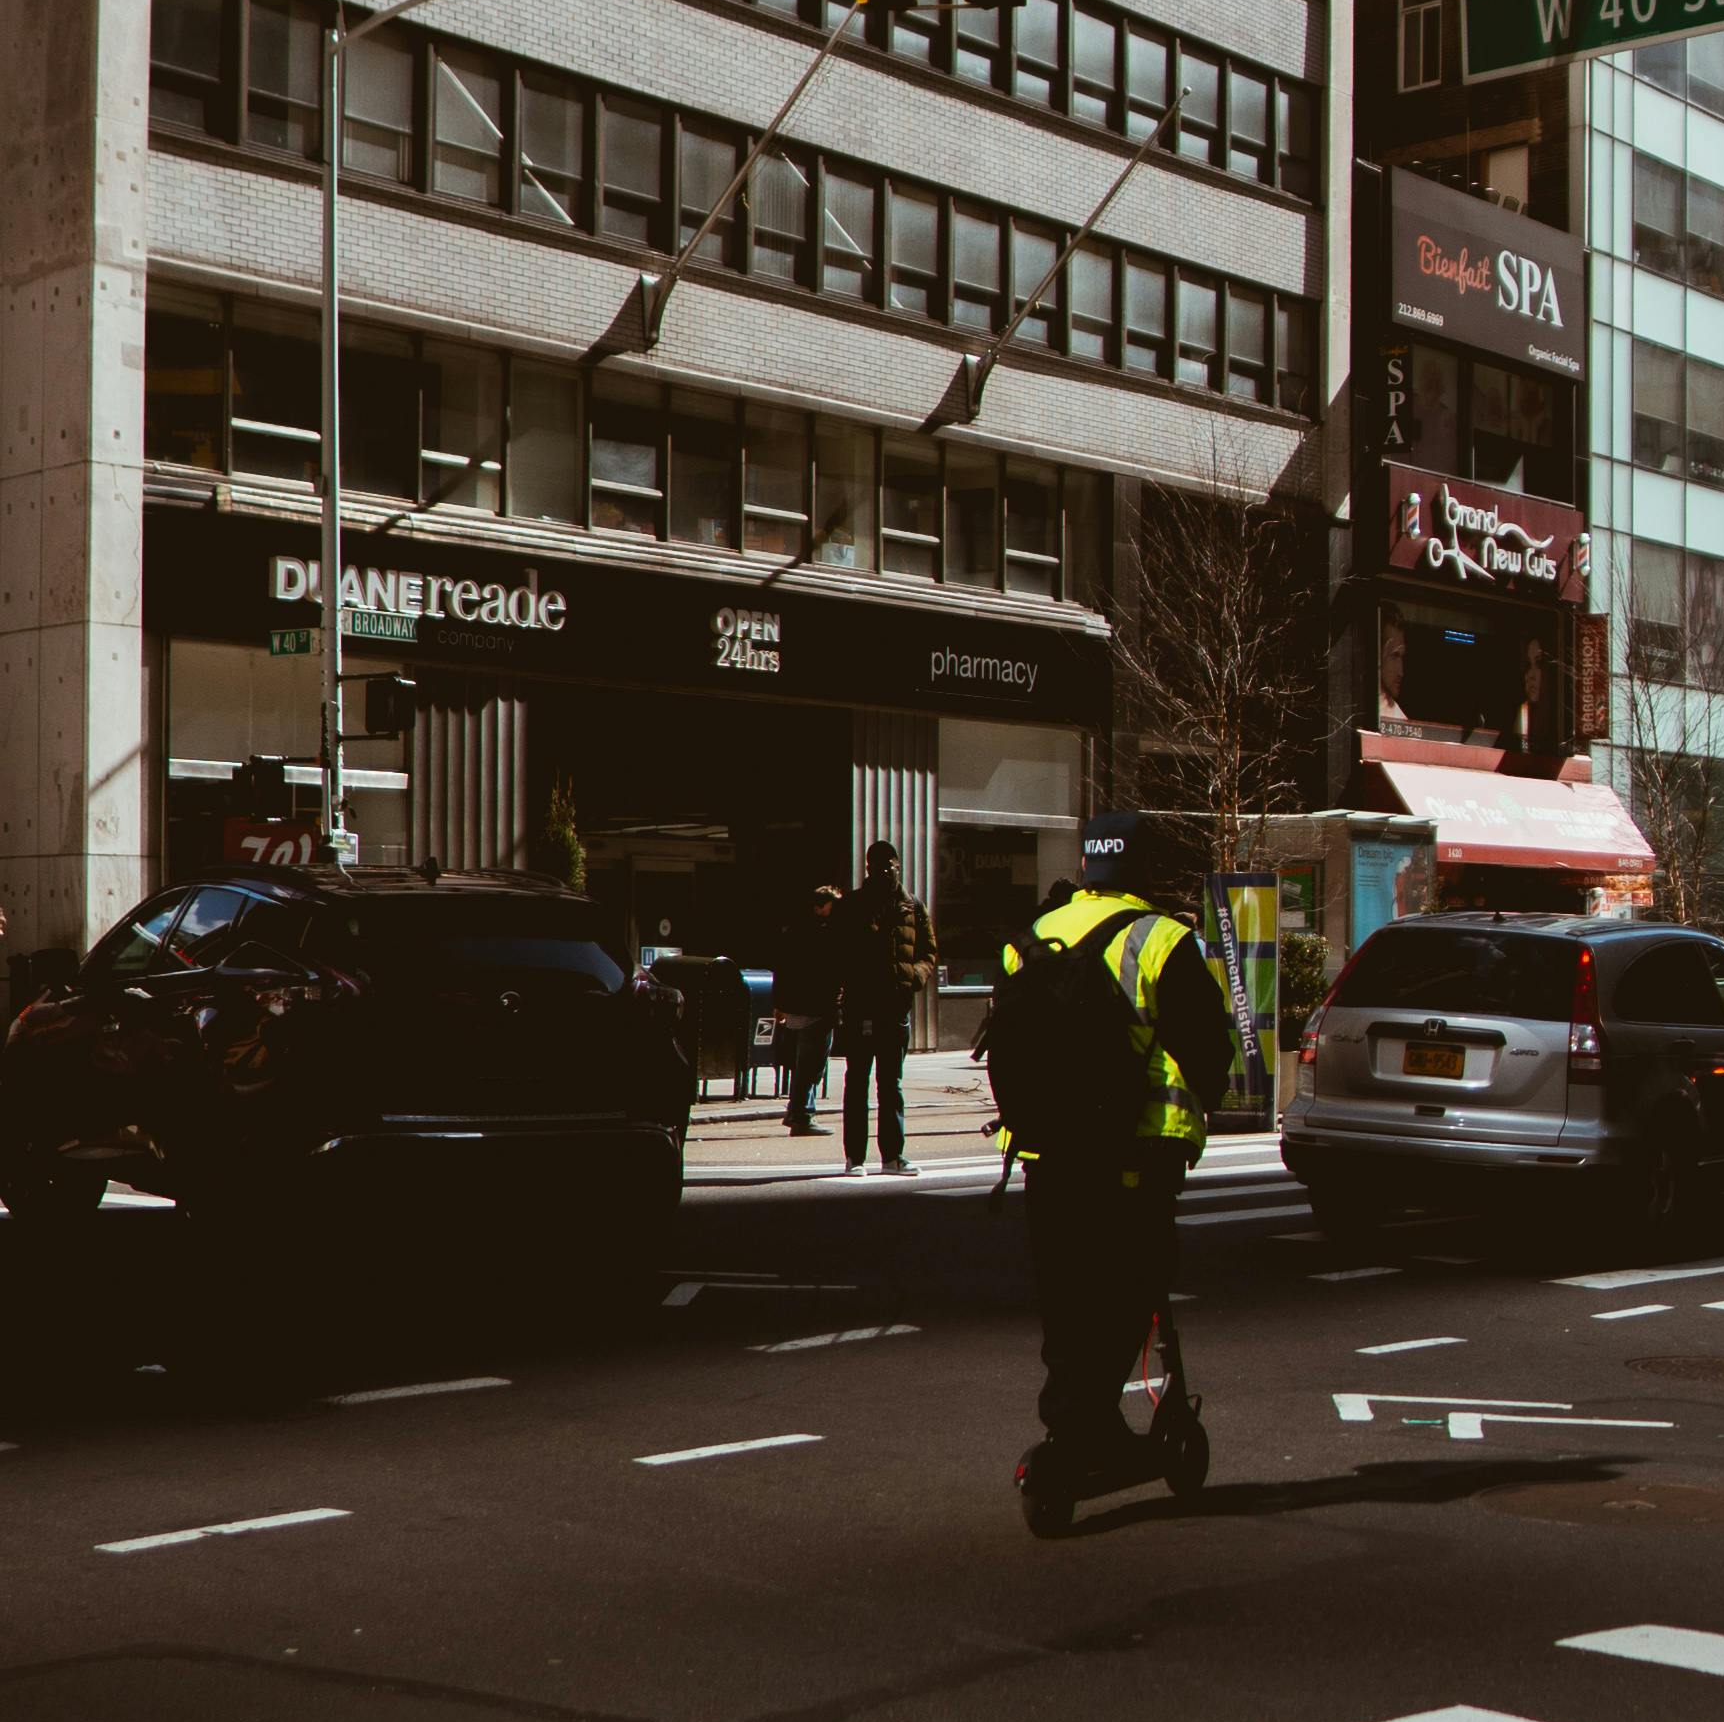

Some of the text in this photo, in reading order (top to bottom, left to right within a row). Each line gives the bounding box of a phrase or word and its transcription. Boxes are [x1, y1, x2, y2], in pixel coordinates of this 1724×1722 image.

[1416, 233, 1565, 328] Bienfait SPA
[1384, 358, 1406, 445] SPA
[1482, 536, 1556, 580] New Cuts
[272, 633, 281, 652] W
[282, 631, 297, 652] 40
[354, 613, 415, 639] BROADWAY
[438, 629, 514, 653] company
[712, 607, 781, 642] OPEN
[715, 635, 781, 673] 24hrs
[931, 646, 1039, 693] pharmacy
[1582, 637, 1594, 735] BARBERSHOP
[1217, 907, 1258, 1058] #GarmentDistrict
